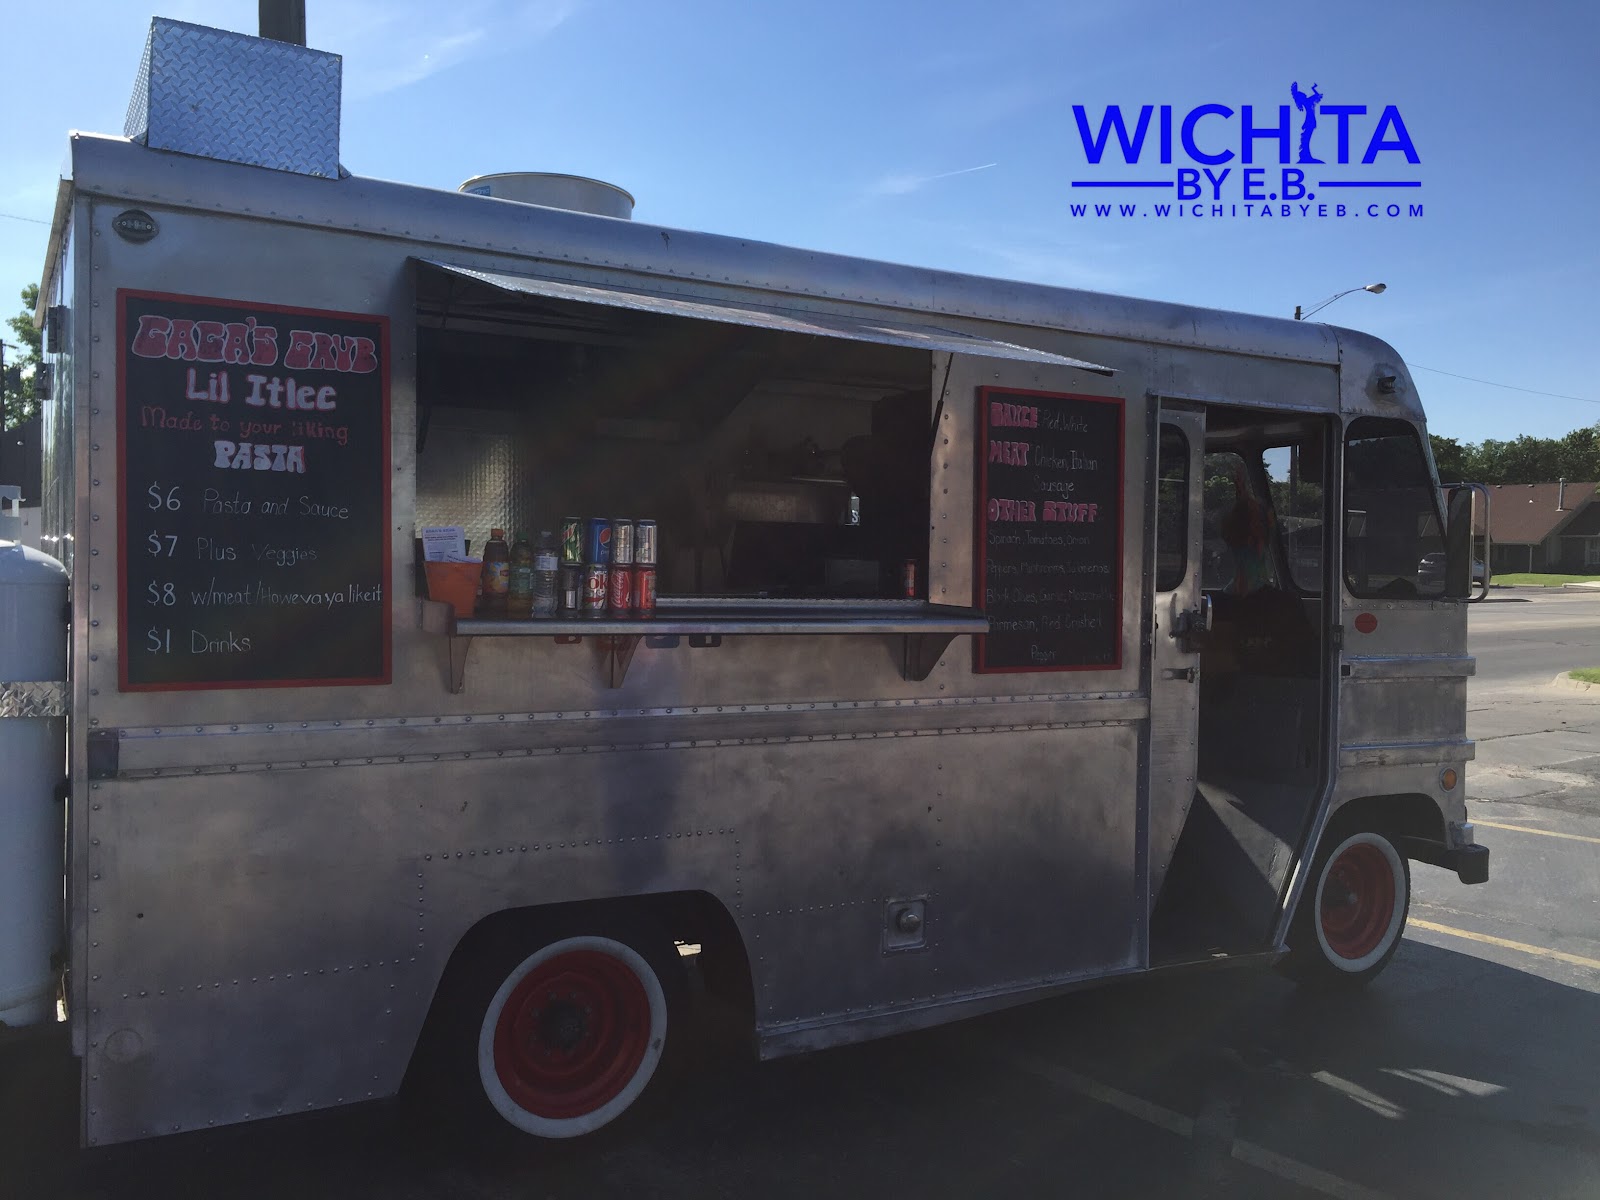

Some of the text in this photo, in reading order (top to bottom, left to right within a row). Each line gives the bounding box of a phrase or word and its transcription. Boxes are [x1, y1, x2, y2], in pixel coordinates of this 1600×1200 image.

[131, 314, 378, 374] GAGA'S GRUB
[185, 367, 337, 412] Lil Itlee
[141, 405, 203, 431] Made
[209, 413, 230, 433] to
[239, 420, 282, 439] your
[213, 440, 306, 474] PASTA
[147, 480, 350, 520] $6 Pasta and Sauce
[988, 498, 1036, 522] OTHER
[147, 529, 318, 567] $7 Plus Veggies
[147, 579, 177, 607] $8
[147, 625, 252, 654] $1 Drinks
